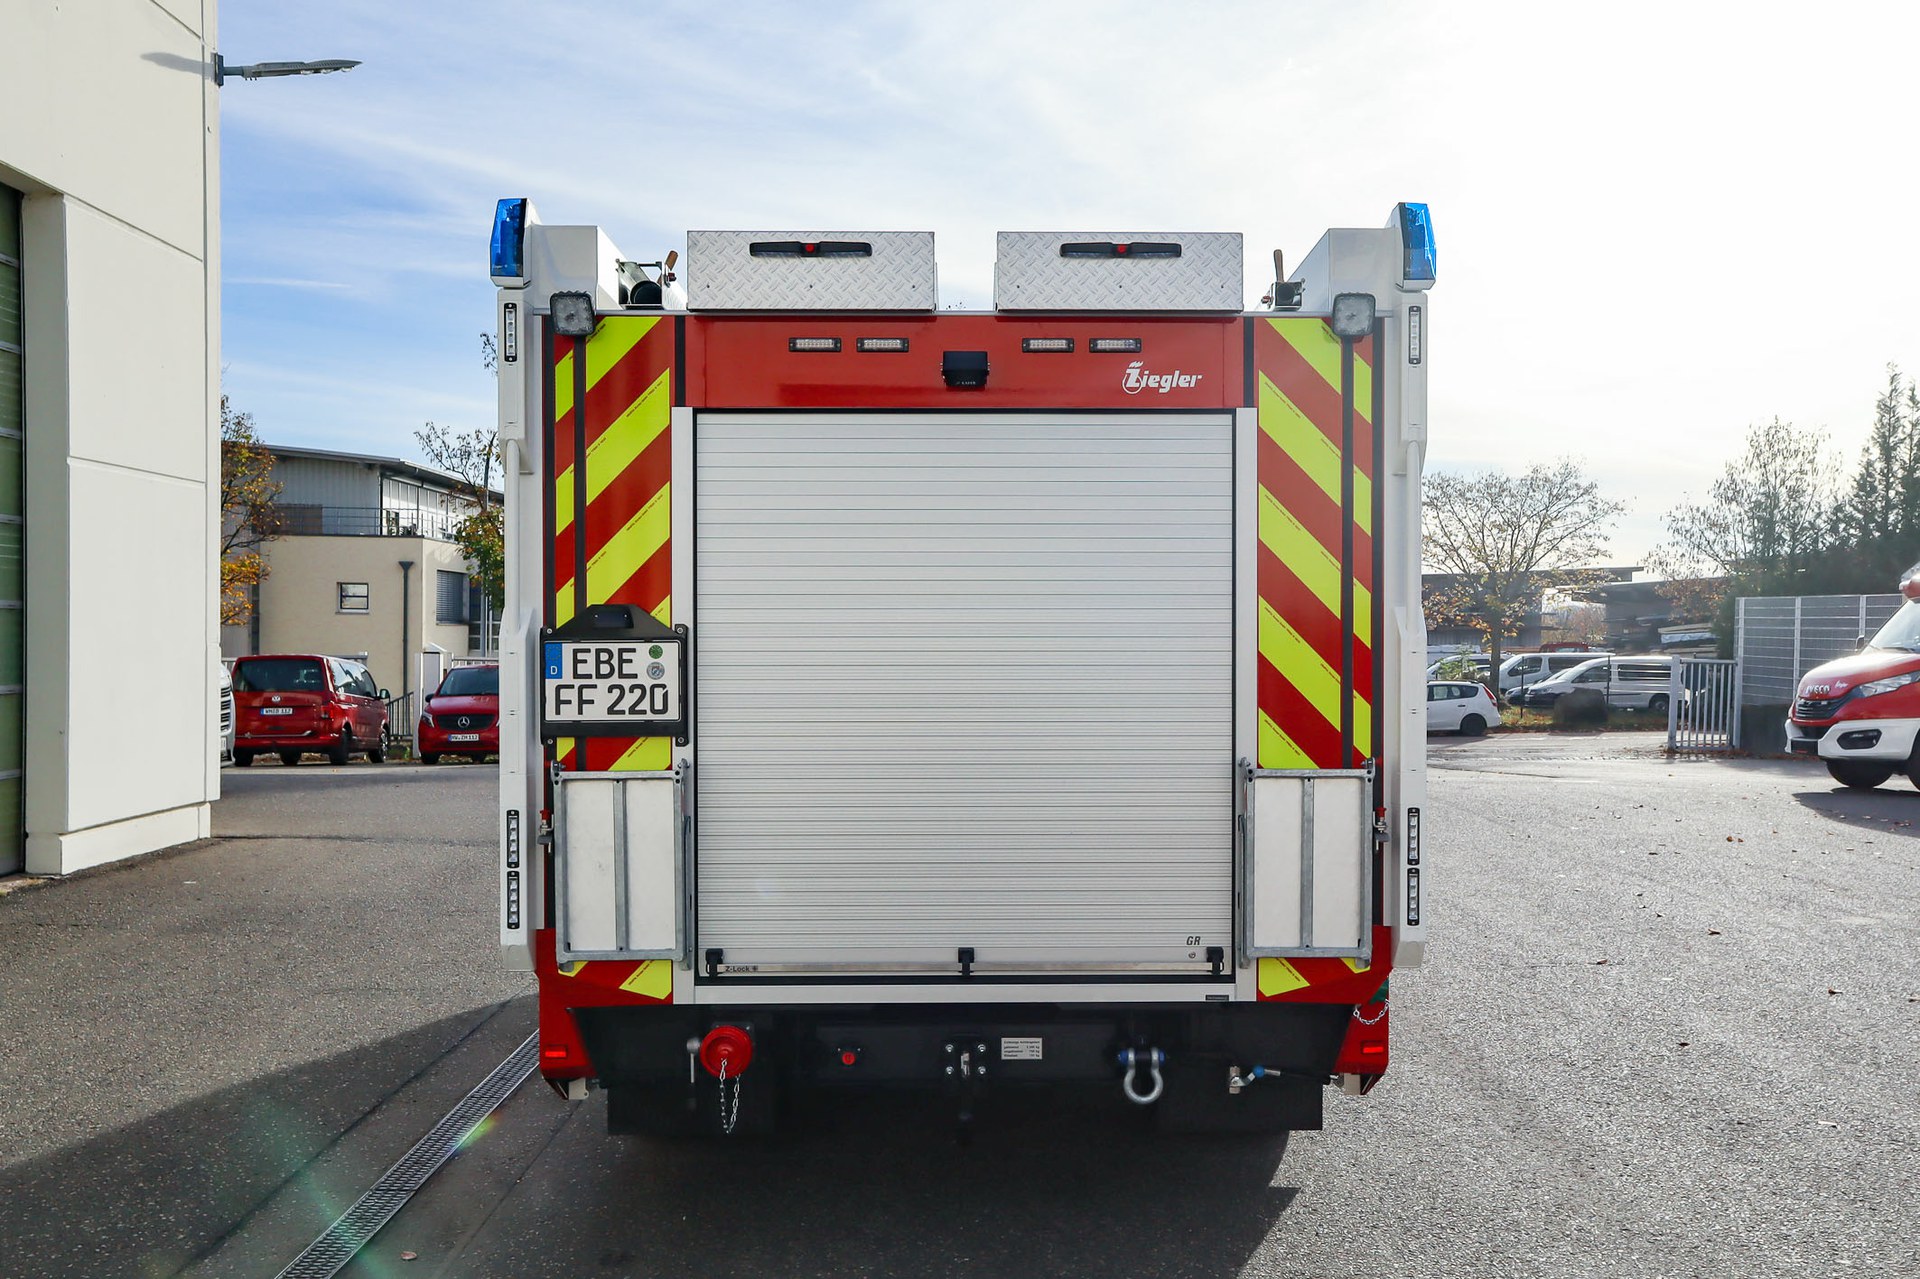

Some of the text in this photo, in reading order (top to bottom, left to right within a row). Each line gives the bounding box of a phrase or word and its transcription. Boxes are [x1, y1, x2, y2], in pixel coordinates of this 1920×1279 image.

[1122, 361, 1203, 394] Ziegler
[550, 666, 558, 675] D
[572, 648, 638, 679] EBE
[555, 683, 669, 715] FF 220
[1805, 685, 1831, 695] IVECO
[1186, 936, 1201, 946] GR
